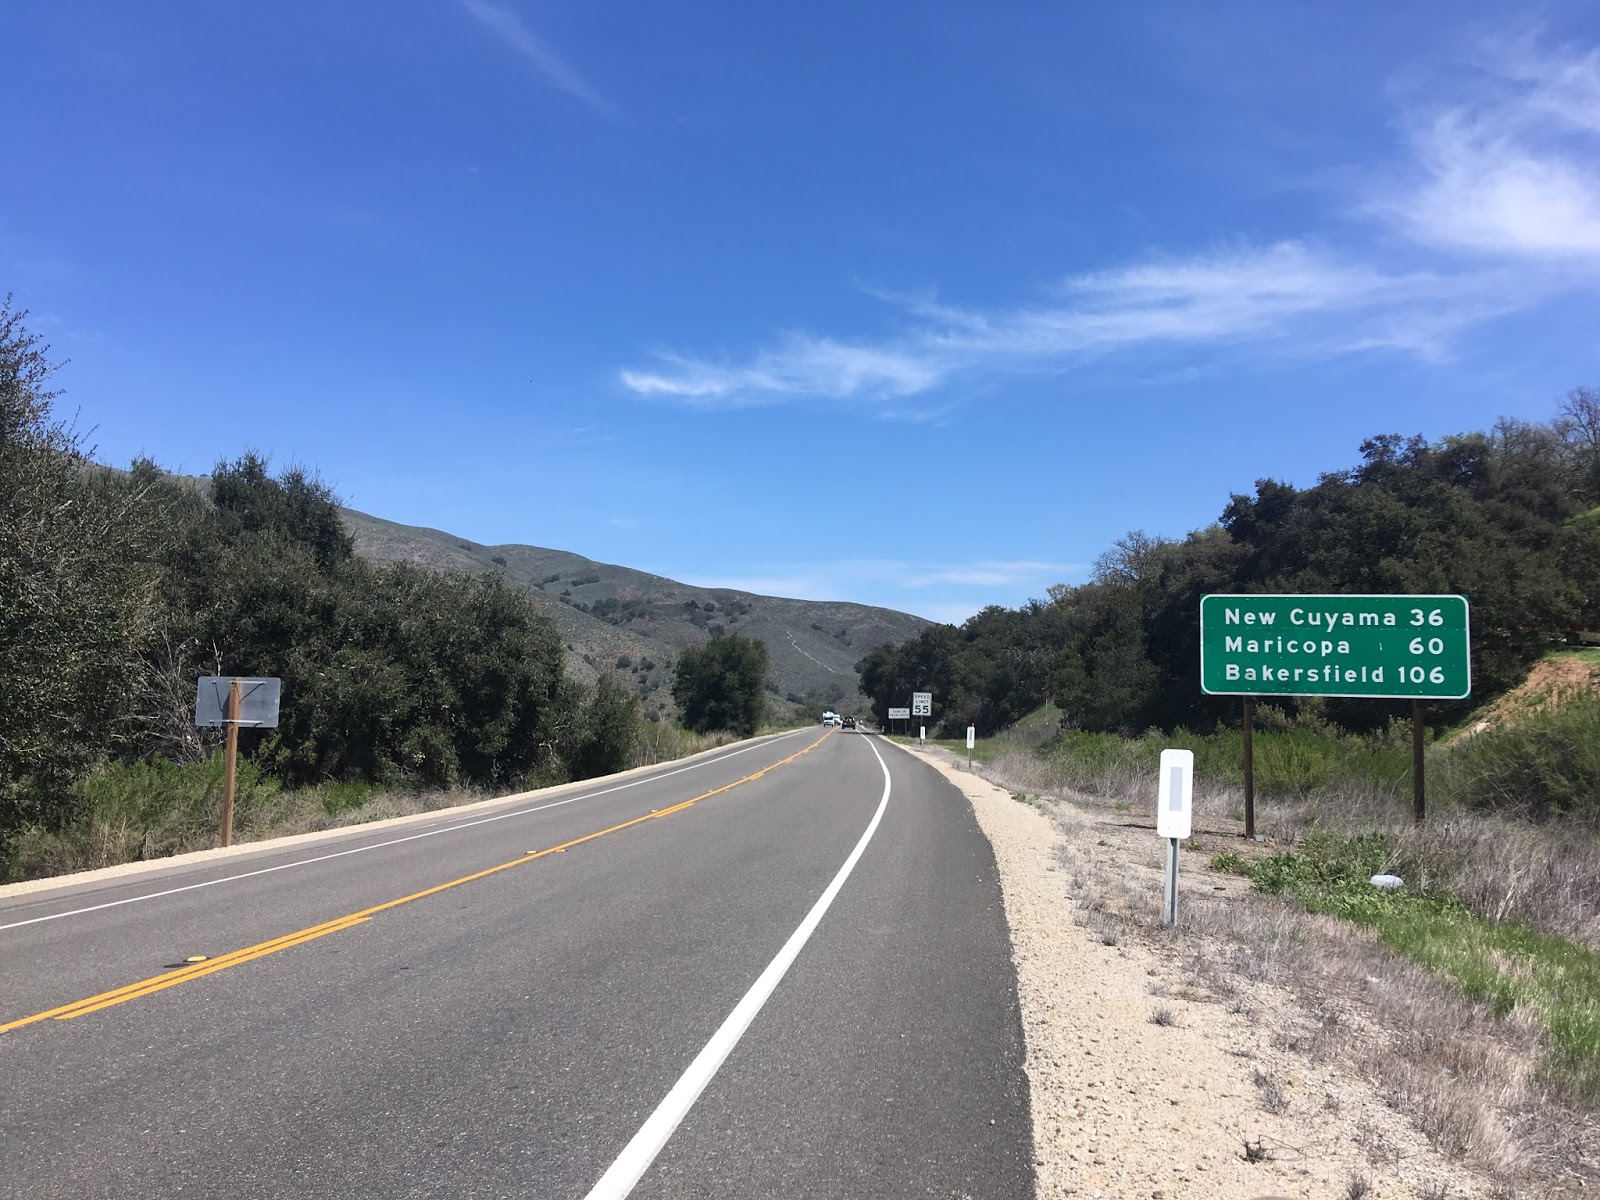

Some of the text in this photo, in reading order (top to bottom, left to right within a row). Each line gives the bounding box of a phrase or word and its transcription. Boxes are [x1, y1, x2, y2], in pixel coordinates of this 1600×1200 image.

[1225, 608, 1444, 632] New Cuyama 36
[1225, 636, 1444, 657] Maricopa 60
[1226, 664, 1445, 684] Bakersfield 106
[914, 705, 929, 714] 55
